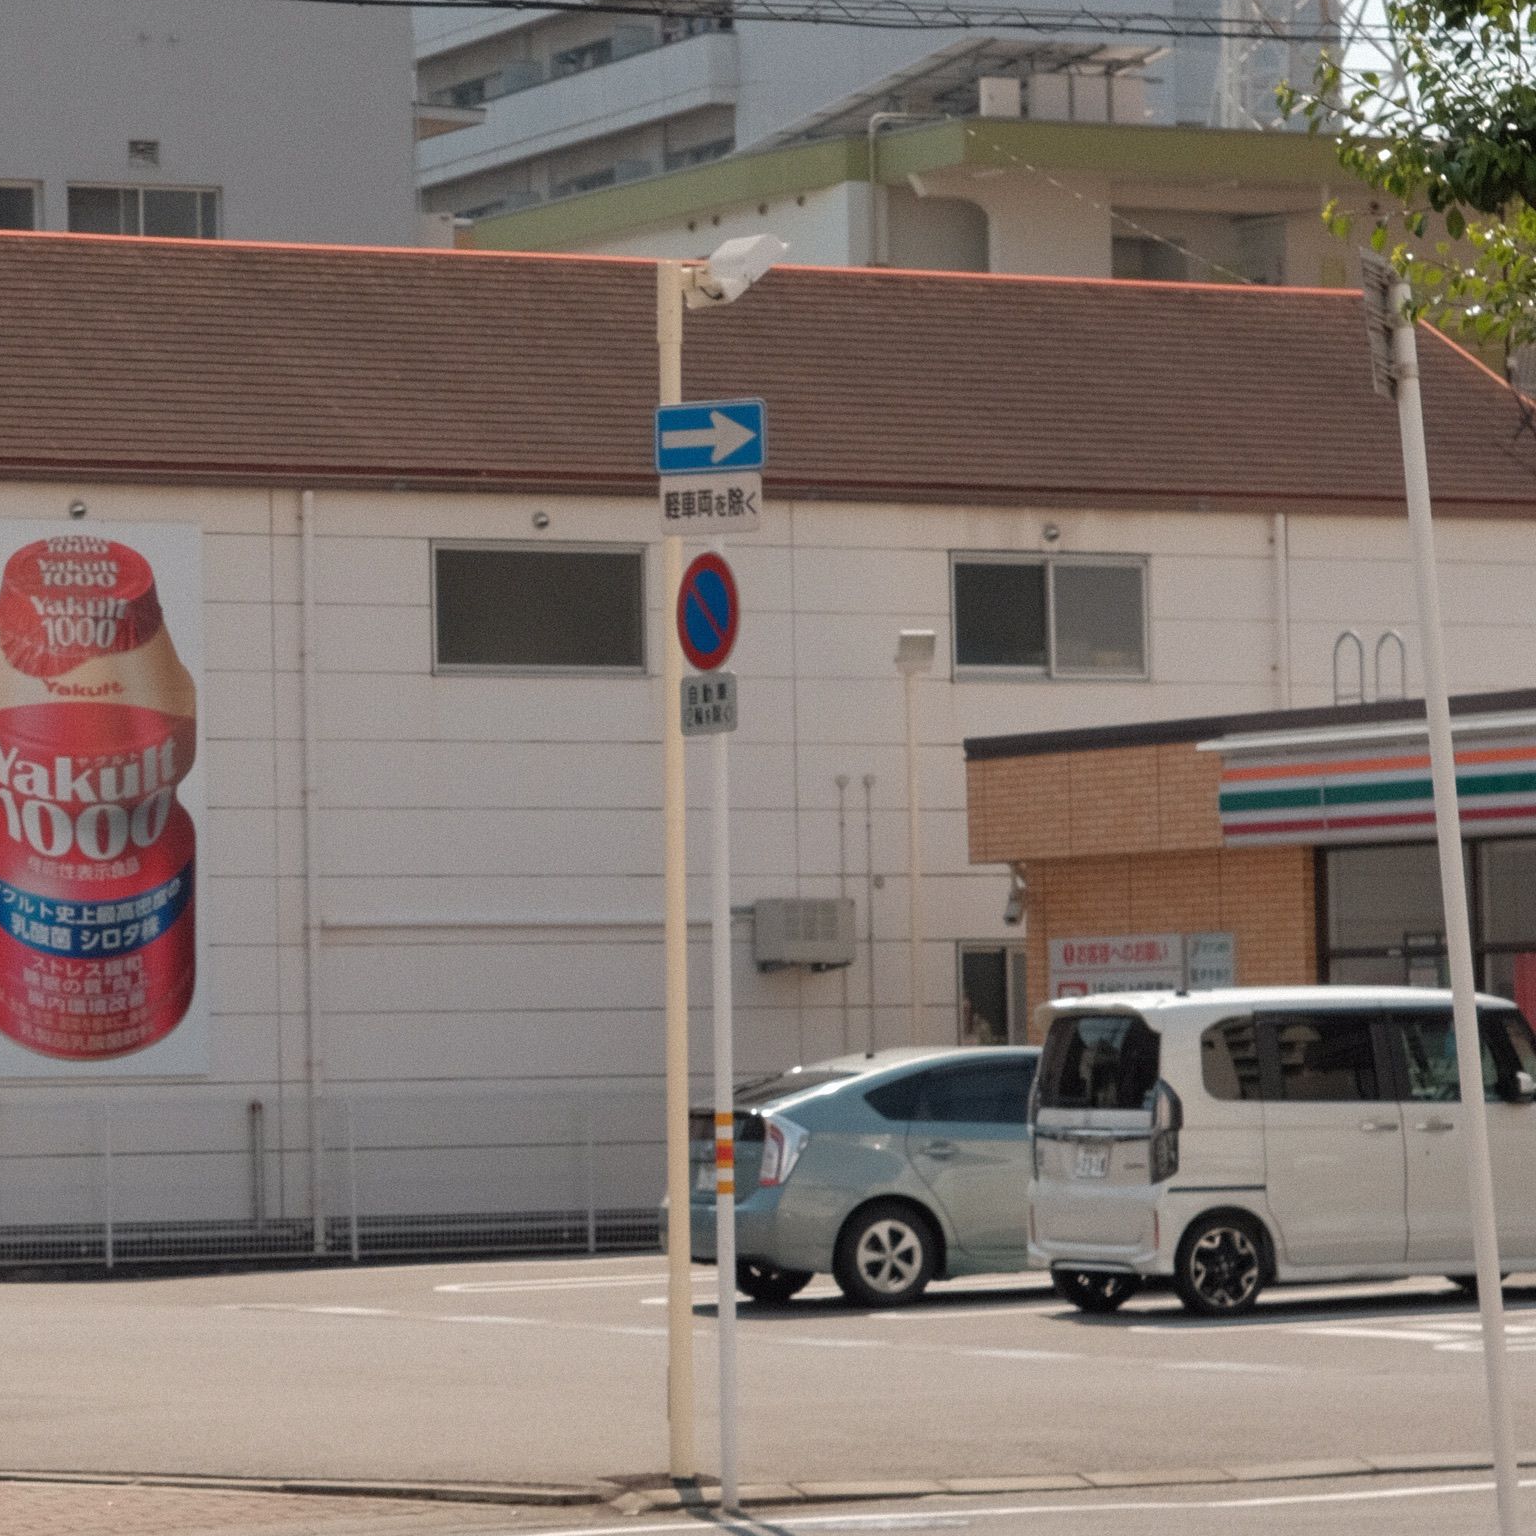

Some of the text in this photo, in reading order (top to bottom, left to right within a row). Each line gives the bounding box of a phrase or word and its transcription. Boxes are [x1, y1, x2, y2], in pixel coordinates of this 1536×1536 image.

[665, 488, 758, 520] 軽車両を除く
[42, 571, 117, 588] 1000
[30, 595, 129, 620] Yakult
[41, 616, 117, 649] 1000
[44, 680, 126, 697] Yakult
